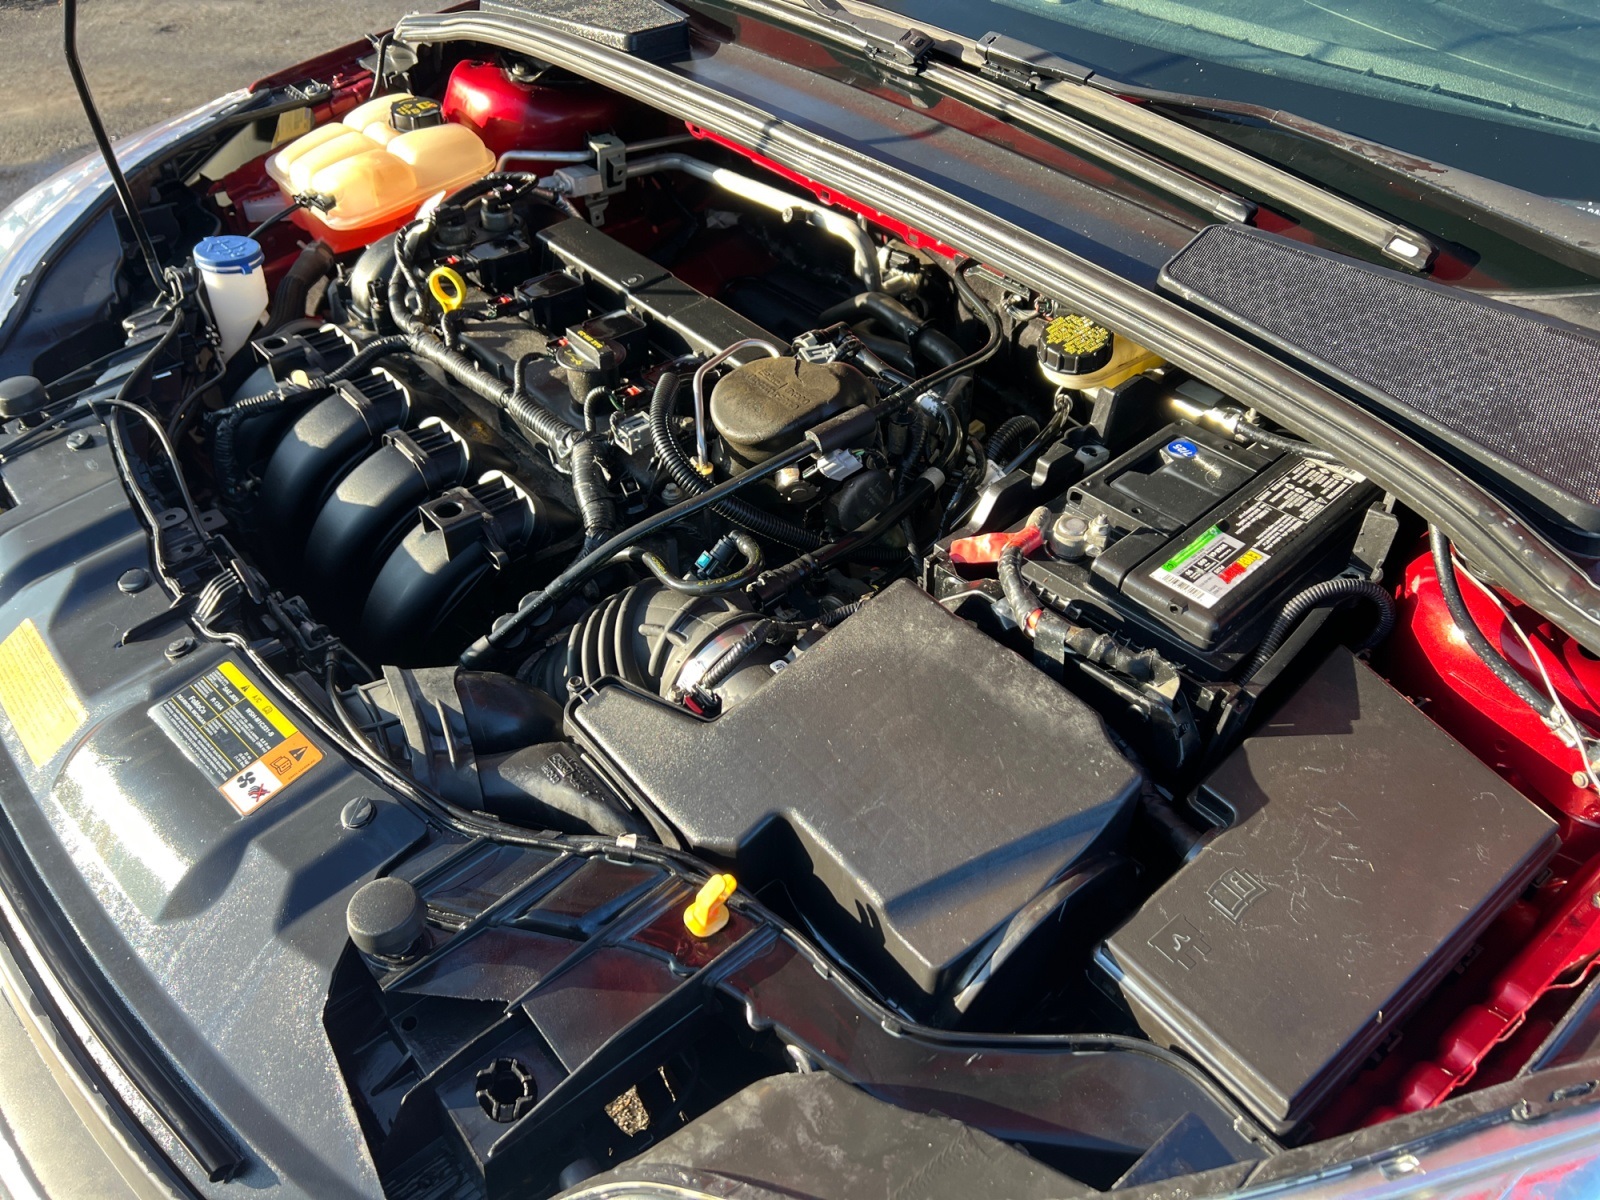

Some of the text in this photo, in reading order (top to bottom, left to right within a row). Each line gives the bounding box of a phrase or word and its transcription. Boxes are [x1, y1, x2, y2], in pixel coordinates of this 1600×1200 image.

[1172, 443, 1193, 457] 7/25
[1218, 550, 1263, 584] EverStart
[221, 685, 233, 695] SAE
[187, 695, 208, 714] FoMoCo
[251, 694, 262, 703] A/C
